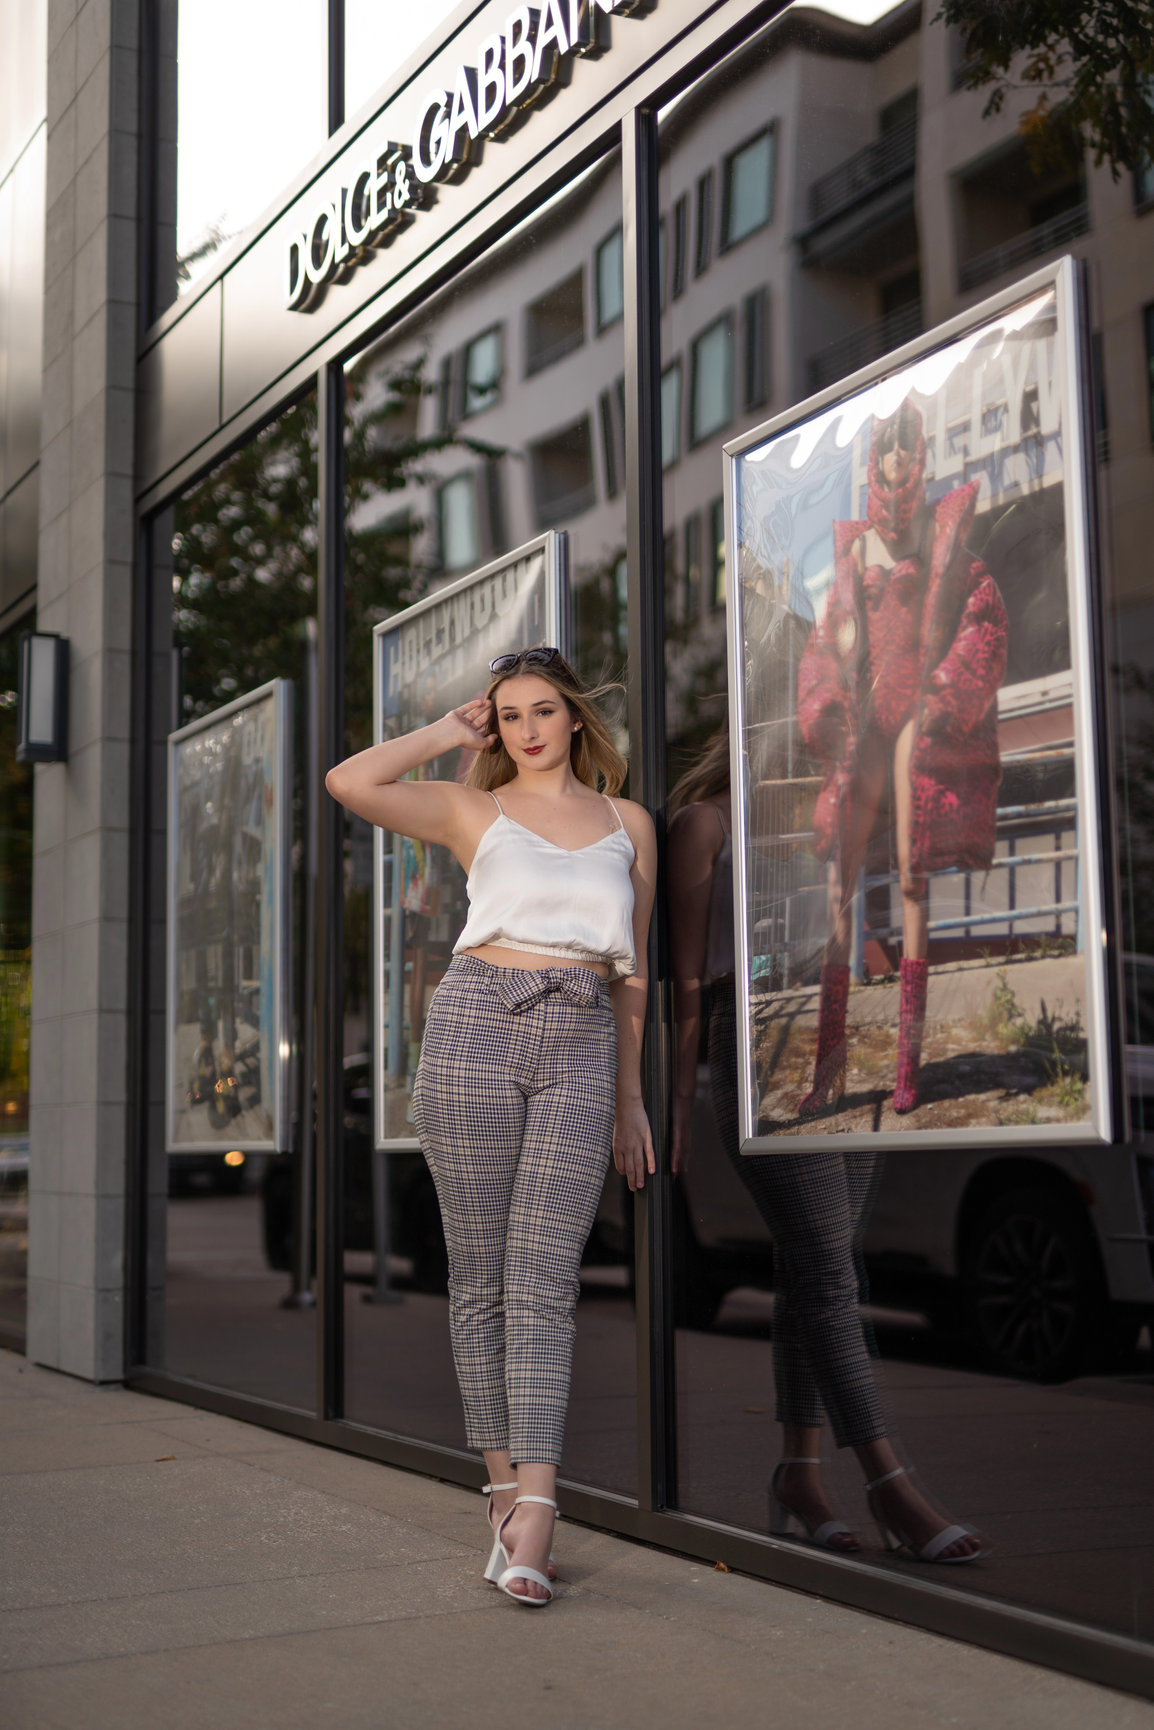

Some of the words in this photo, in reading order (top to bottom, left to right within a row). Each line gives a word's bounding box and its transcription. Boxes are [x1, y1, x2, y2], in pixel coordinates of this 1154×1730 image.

[283, 141, 393, 309] DOLCE
[393, 160, 411, 209] &
[412, 0, 624, 184] GABBA
